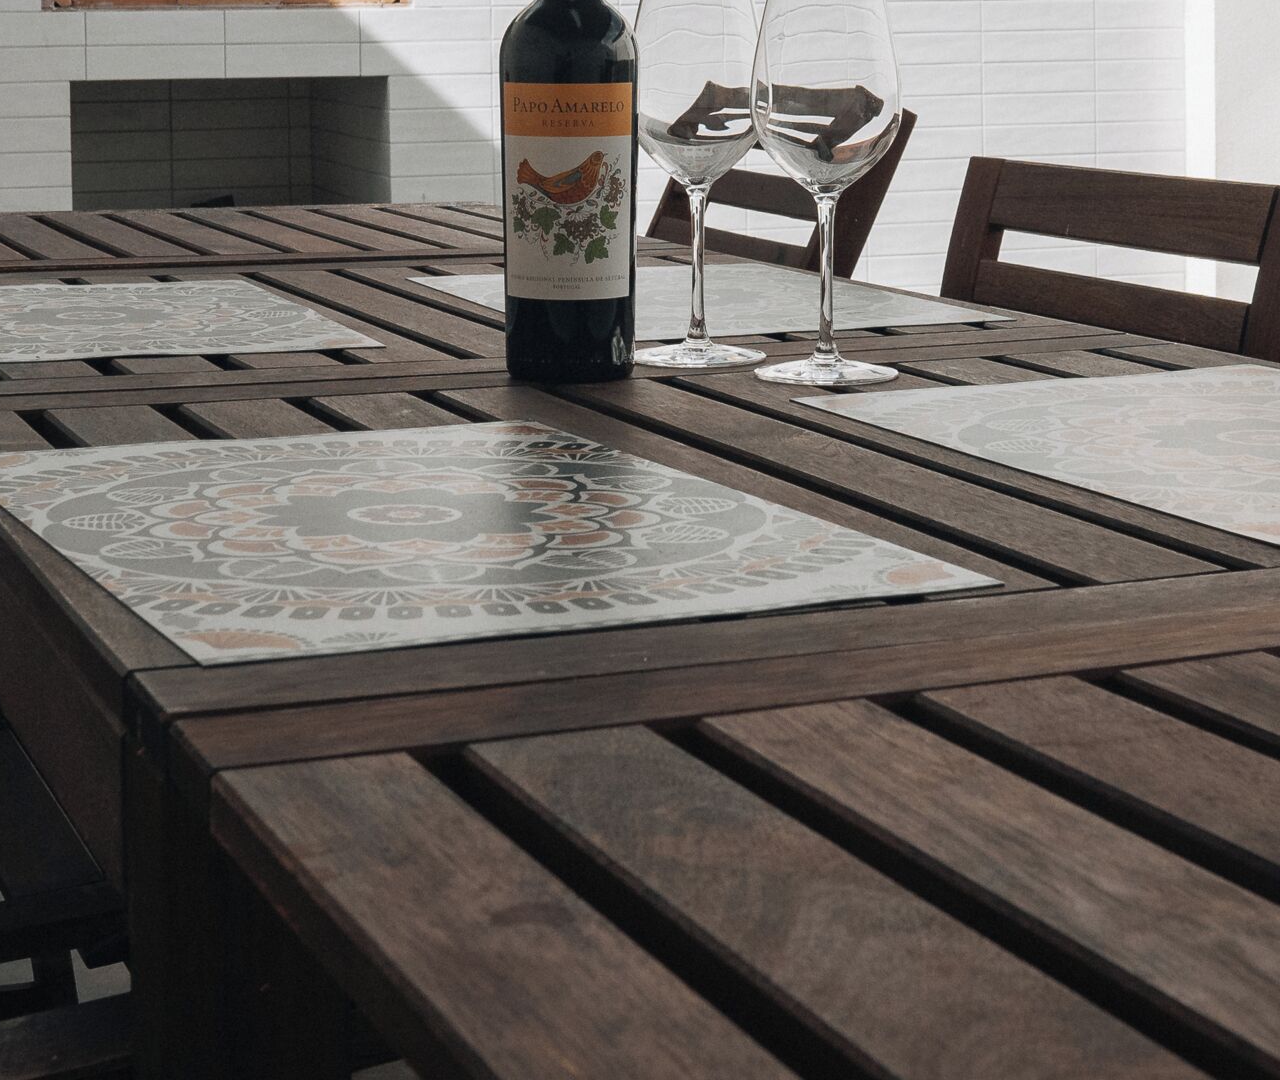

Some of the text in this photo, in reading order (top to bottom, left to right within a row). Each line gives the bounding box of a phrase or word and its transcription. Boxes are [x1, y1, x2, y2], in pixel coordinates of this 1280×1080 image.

[513, 96, 624, 113] PAPO AMARELO
[542, 119, 595, 128] RESERVA
